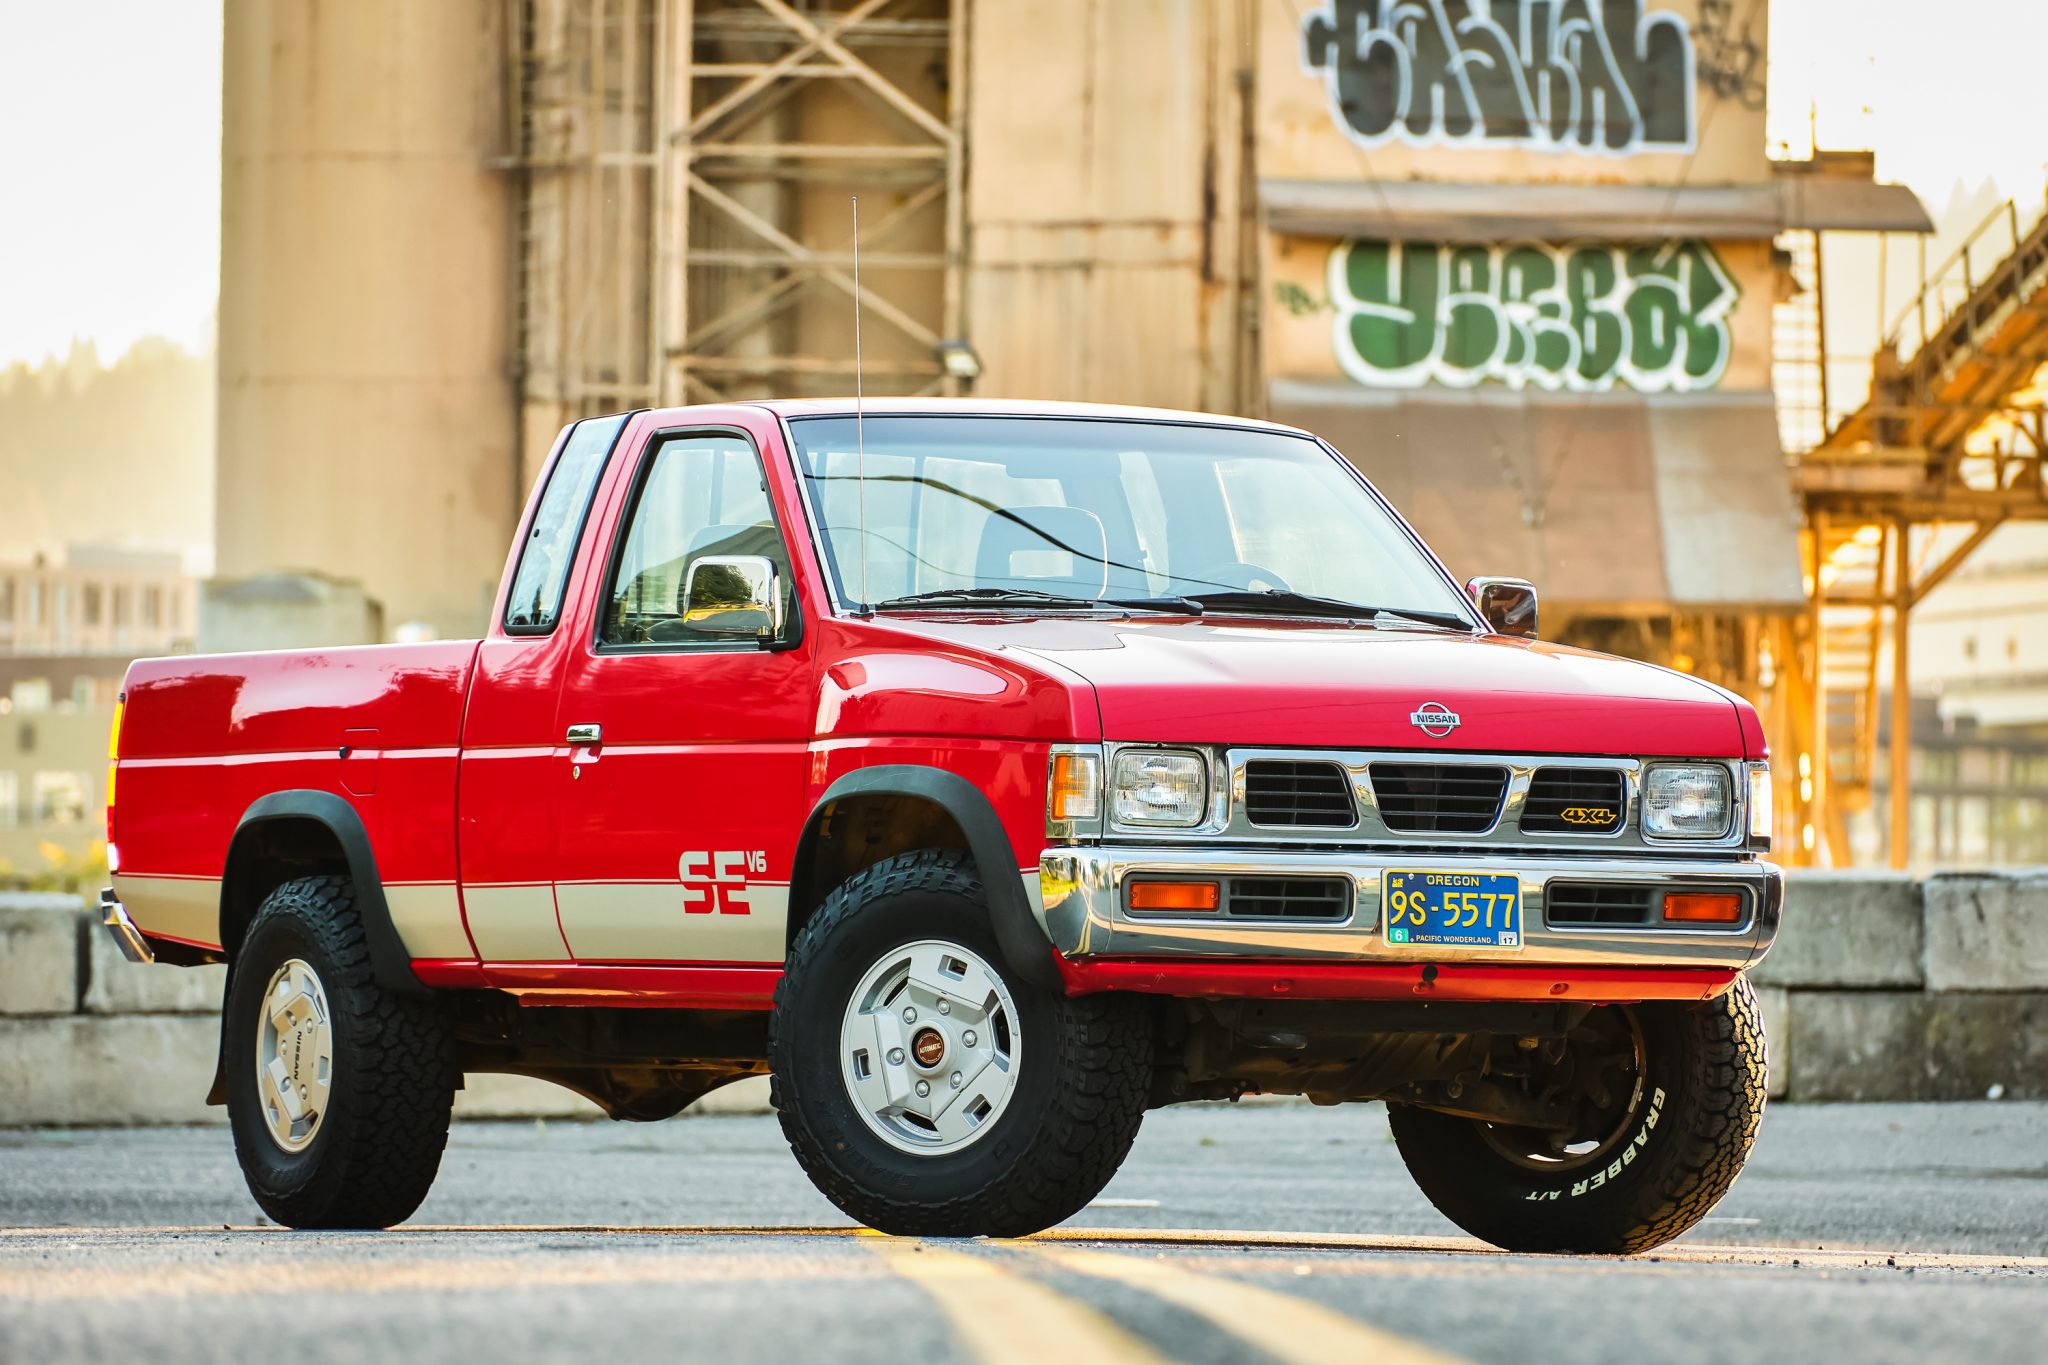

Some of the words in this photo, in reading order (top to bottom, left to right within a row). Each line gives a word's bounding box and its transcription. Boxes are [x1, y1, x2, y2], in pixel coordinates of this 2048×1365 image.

[1416, 714, 1457, 724] NISSAN
[679, 851, 751, 915] SE
[745, 850, 767, 872] V6
[1426, 875, 1480, 887] OREGON
[1390, 890, 1516, 928] 9S-5577
[1395, 930, 1403, 941] 6
[1443, 935, 1492, 944] WONDERLAND
[1503, 937, 1513, 945] 17
[294, 1031, 302, 1080] NISSAN
[1571, 1087, 1666, 1197] GRABBER
[1525, 1190, 1562, 1201] A/T
